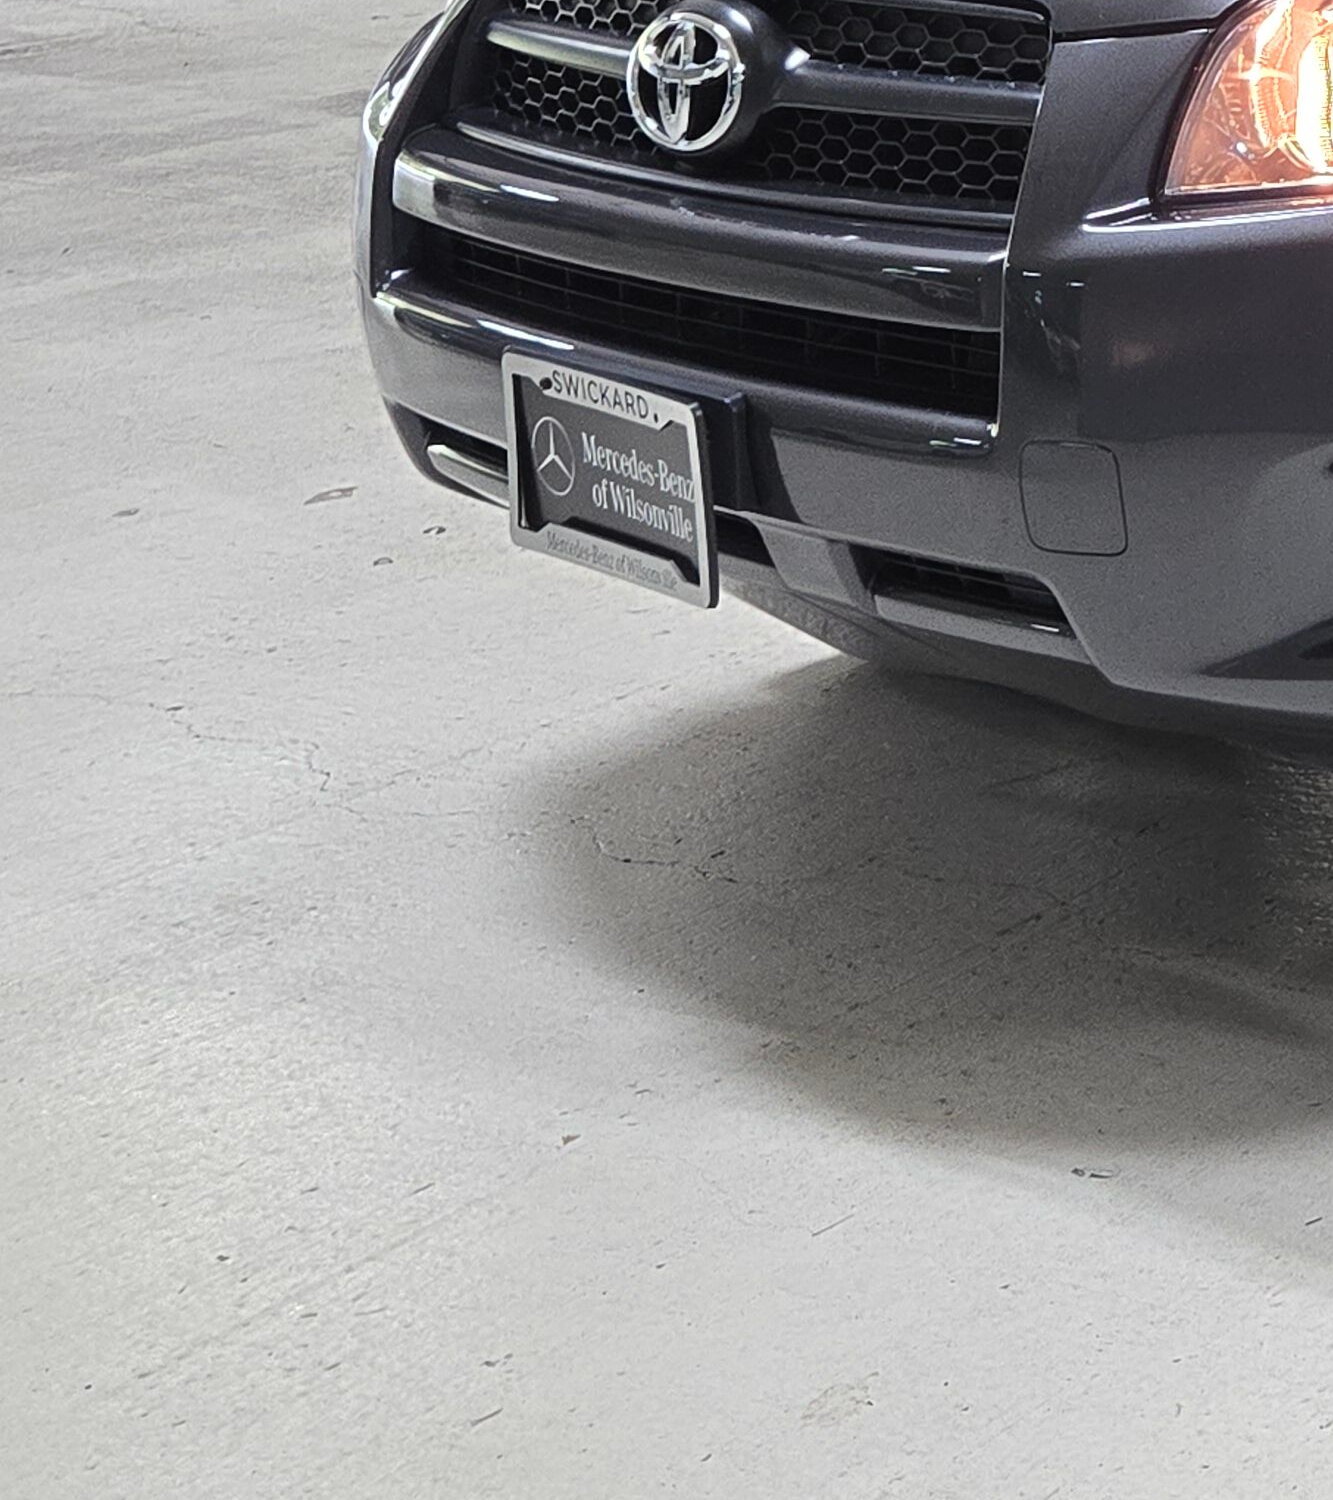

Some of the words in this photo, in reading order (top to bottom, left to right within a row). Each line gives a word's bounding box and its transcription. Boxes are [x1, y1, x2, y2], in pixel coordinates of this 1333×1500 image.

[551, 370, 650, 419] SWICKARD
[581, 431, 696, 503] Mercedes-Benz
[592, 479, 608, 509] of
[609, 481, 694, 542] Wilsonville
